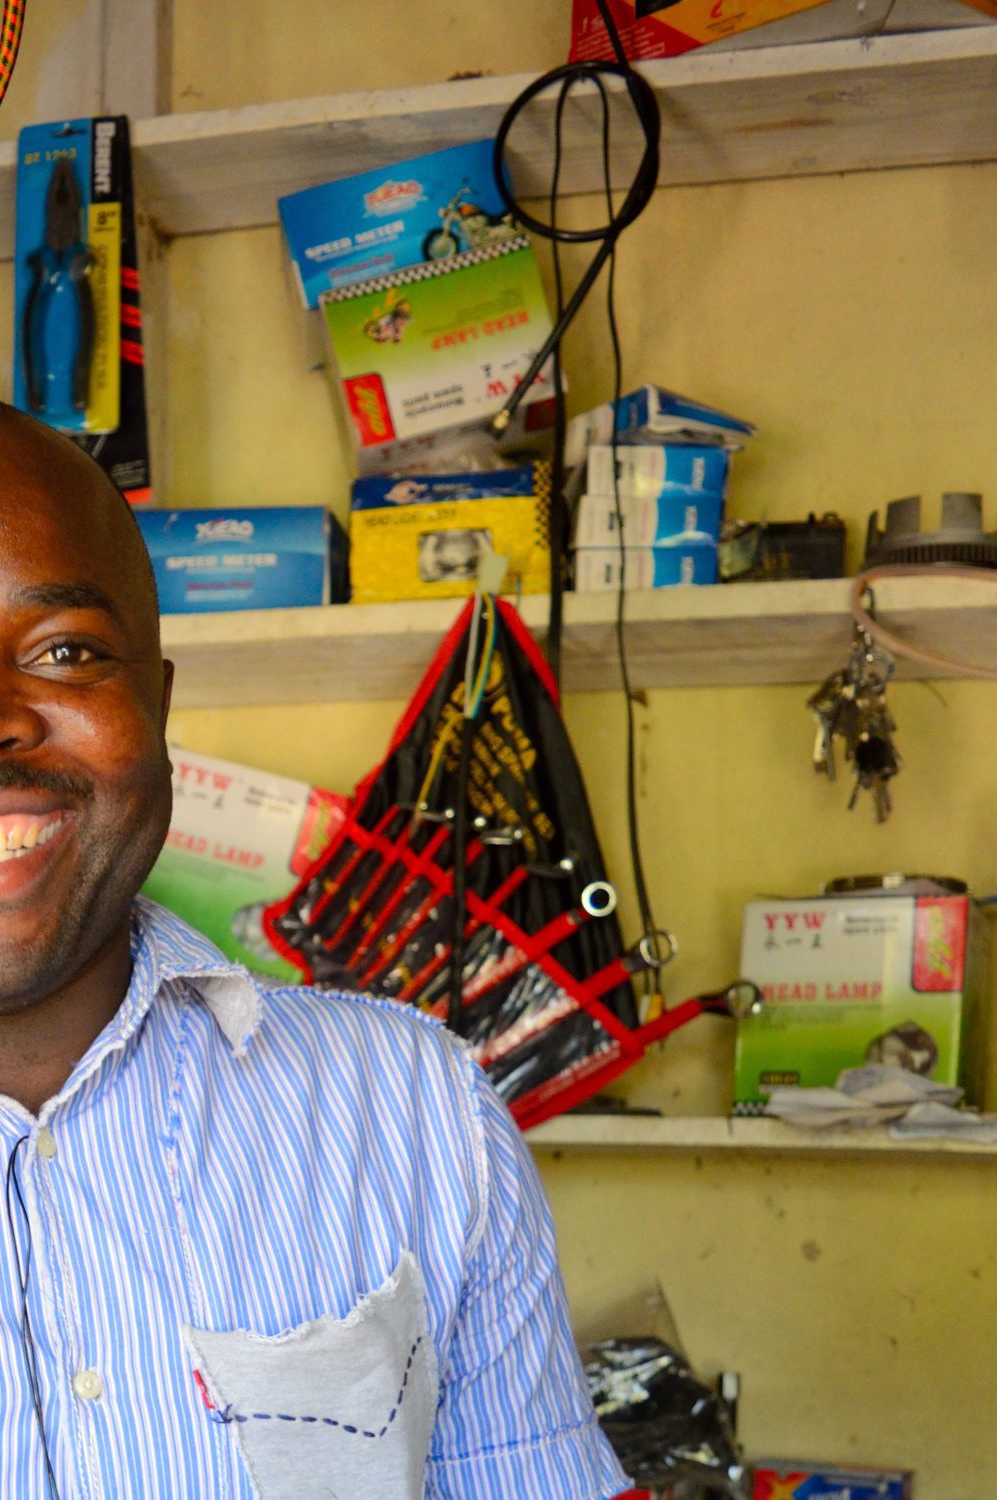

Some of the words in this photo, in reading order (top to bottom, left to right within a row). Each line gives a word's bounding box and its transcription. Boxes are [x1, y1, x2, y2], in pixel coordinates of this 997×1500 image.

[179, 762, 233, 791] YYW
[213, 843, 265, 870] LAMP
[763, 911, 826, 931] YYW
[762, 982, 817, 1002] HEAD
[825, 981, 883, 1002] LAMP
